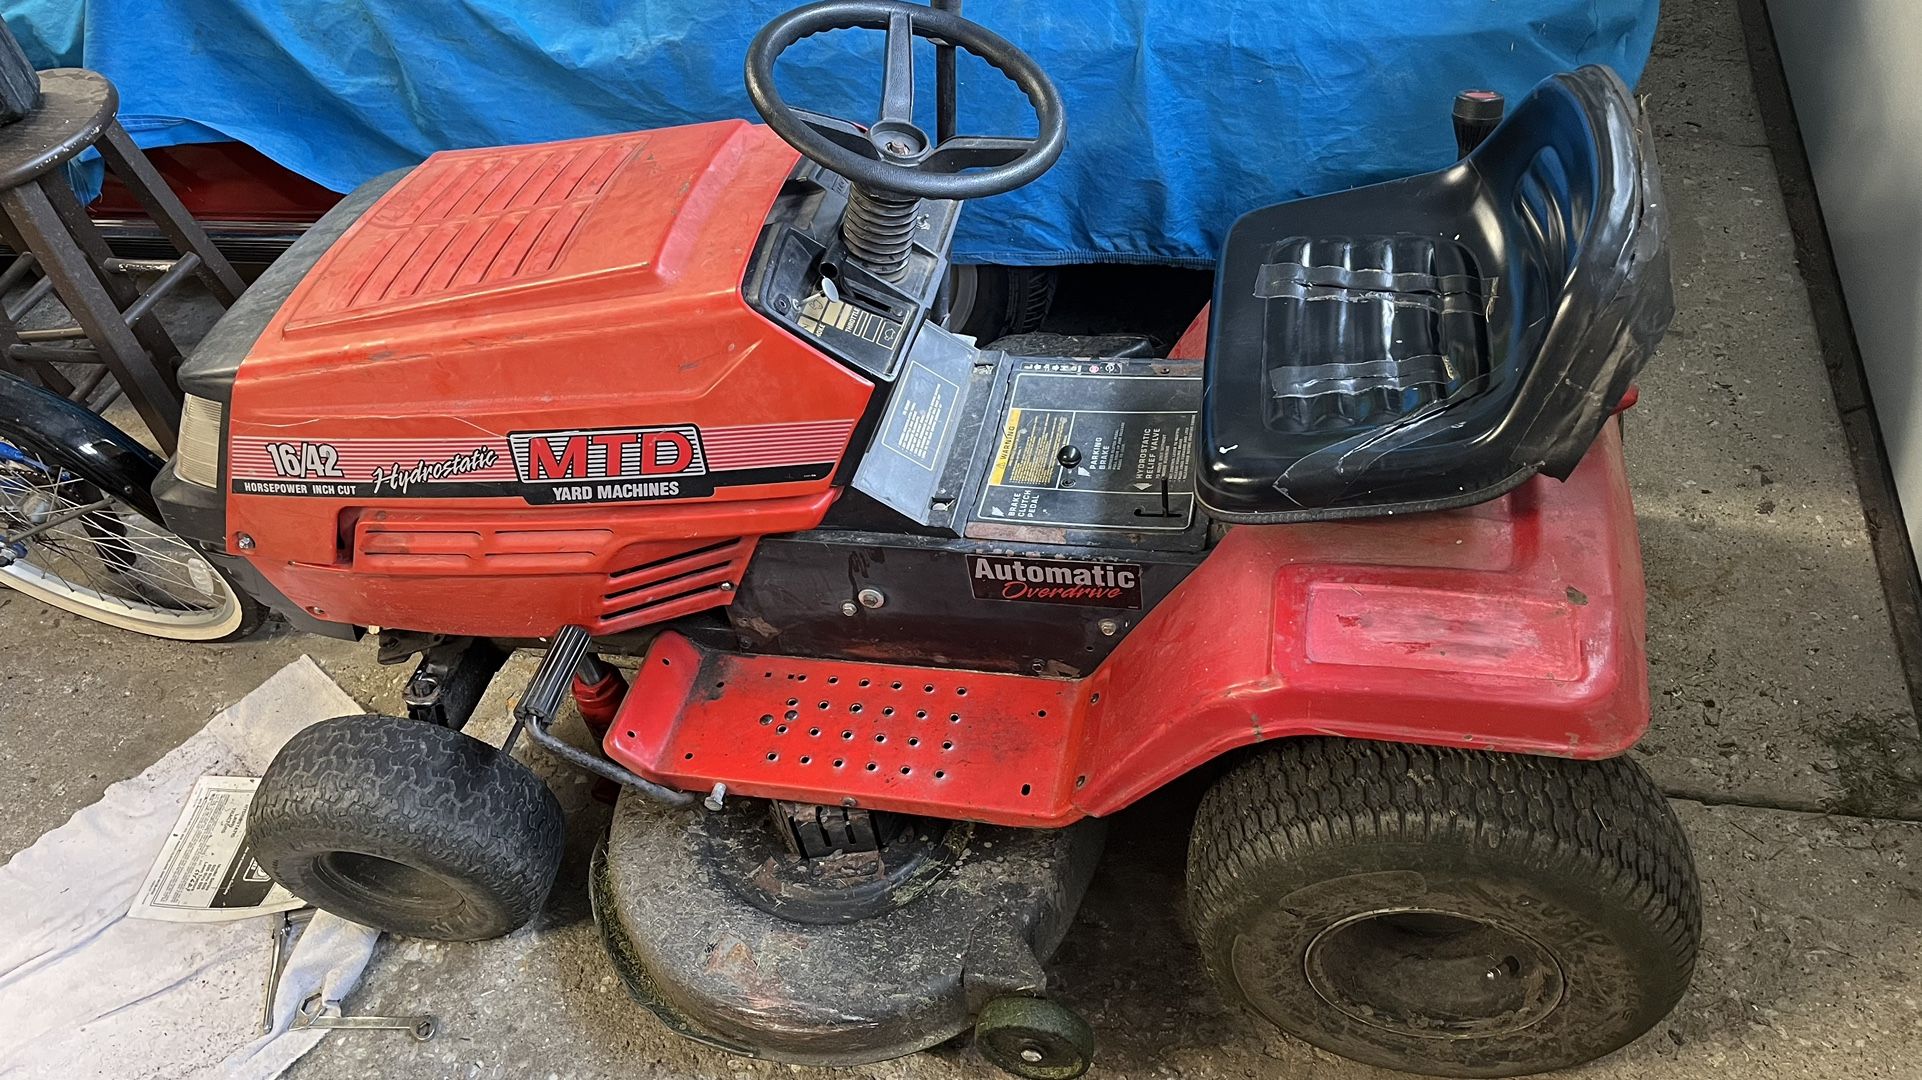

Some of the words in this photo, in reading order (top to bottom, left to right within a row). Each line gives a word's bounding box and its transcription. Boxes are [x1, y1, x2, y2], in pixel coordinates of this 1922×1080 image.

[845, 307, 860, 333] THROTTLE
[1000, 425, 1016, 461] WARNING
[1150, 427, 1161, 450] VALVE
[264, 441, 345, 479] 16/42
[527, 431, 696, 480] MTD
[1089, 437, 1103, 470] PARKING
[1099, 445, 1110, 470] BRAKE
[1136, 428, 1151, 479] HYDROSTATIC
[1145, 450, 1156, 480] RELIEF
[371, 445, 499, 495] Hydrostatic
[244, 481, 308, 495] HORSEPOWER
[312, 483, 336, 495] INCH
[337, 484, 357, 496] CUT
[552, 485, 593, 501] YARD
[597, 481, 680, 500] MACHINES
[1008, 492, 1021, 517] BRAKE
[1018, 489, 1032, 517] CLUTCH
[1027, 494, 1040, 518] PEDAL
[975, 557, 1135, 588] Automatic
[1002, 581, 1123, 599] Overdrive
